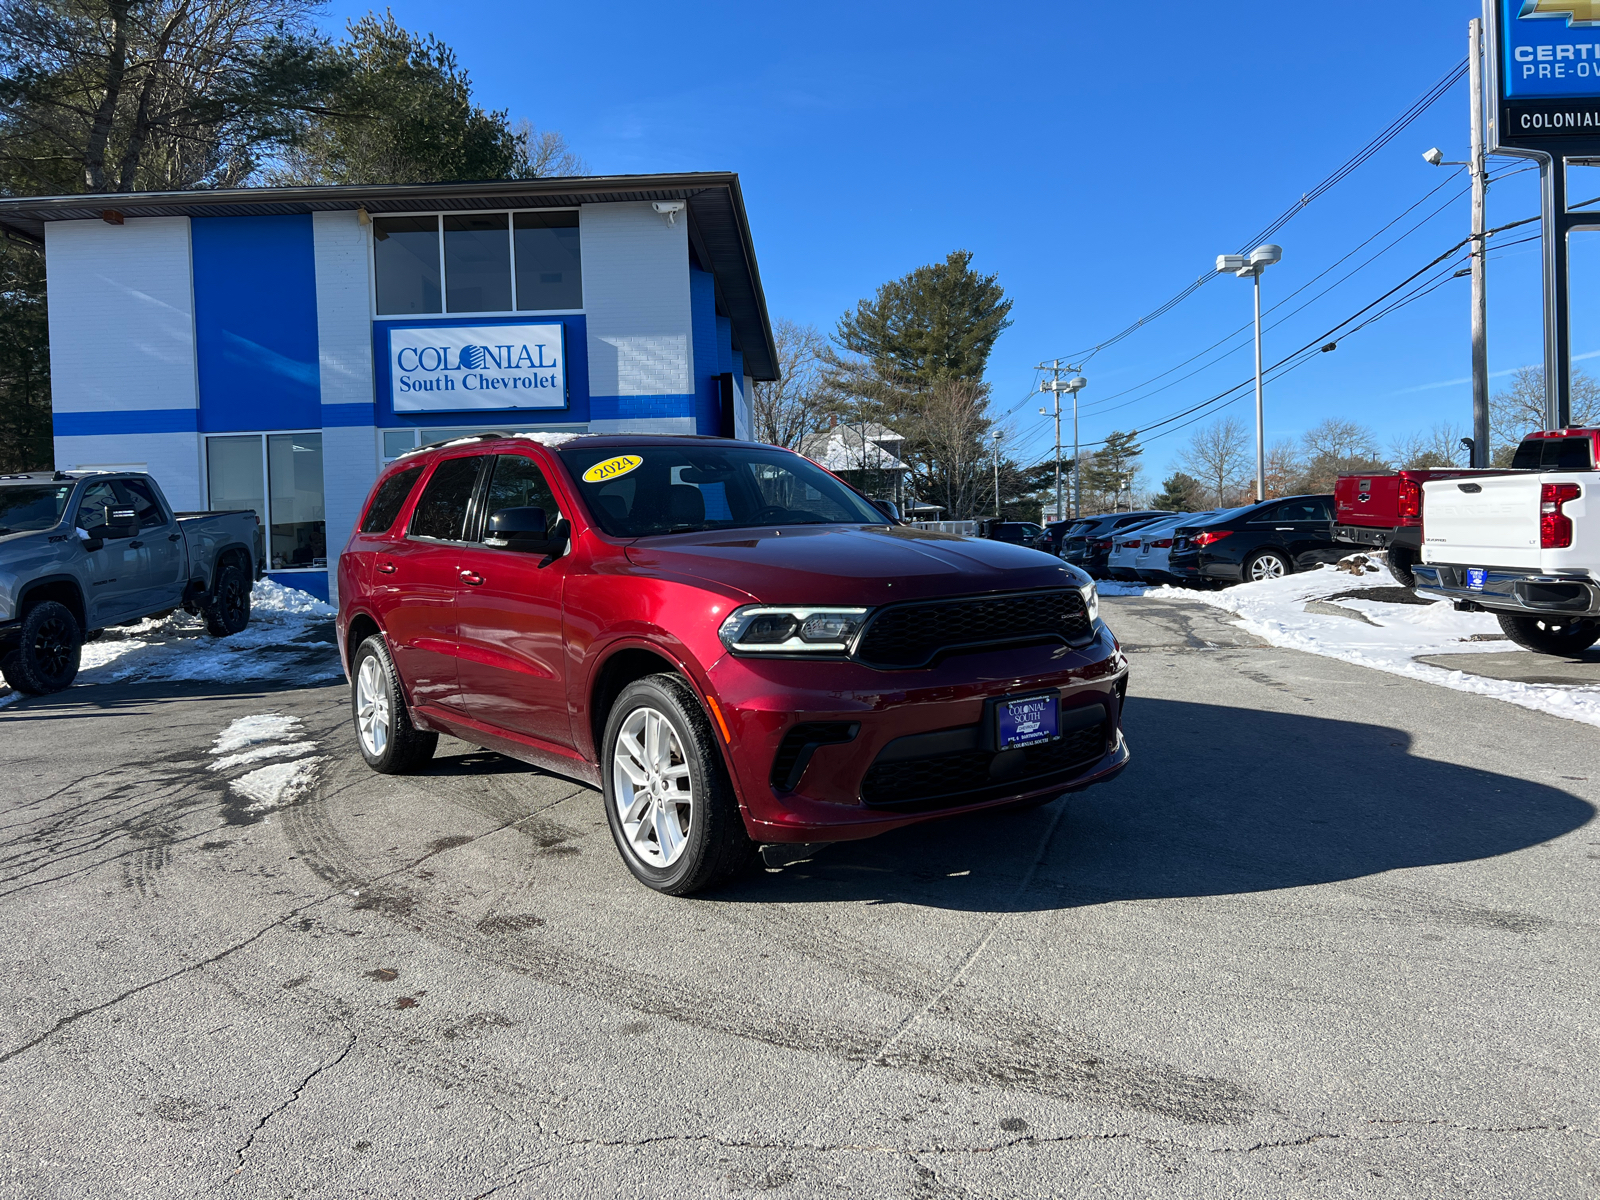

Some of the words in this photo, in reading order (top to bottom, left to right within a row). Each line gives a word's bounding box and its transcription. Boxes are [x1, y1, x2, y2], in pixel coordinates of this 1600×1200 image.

[397, 344, 557, 372] COLONIAL
[400, 375, 455, 392] South
[462, 372, 557, 390] Chevrolet
[594, 457, 634, 478] 2024
[1009, 703, 1046, 716] COLONIAL
[1015, 712, 1040, 724] SOUTH
